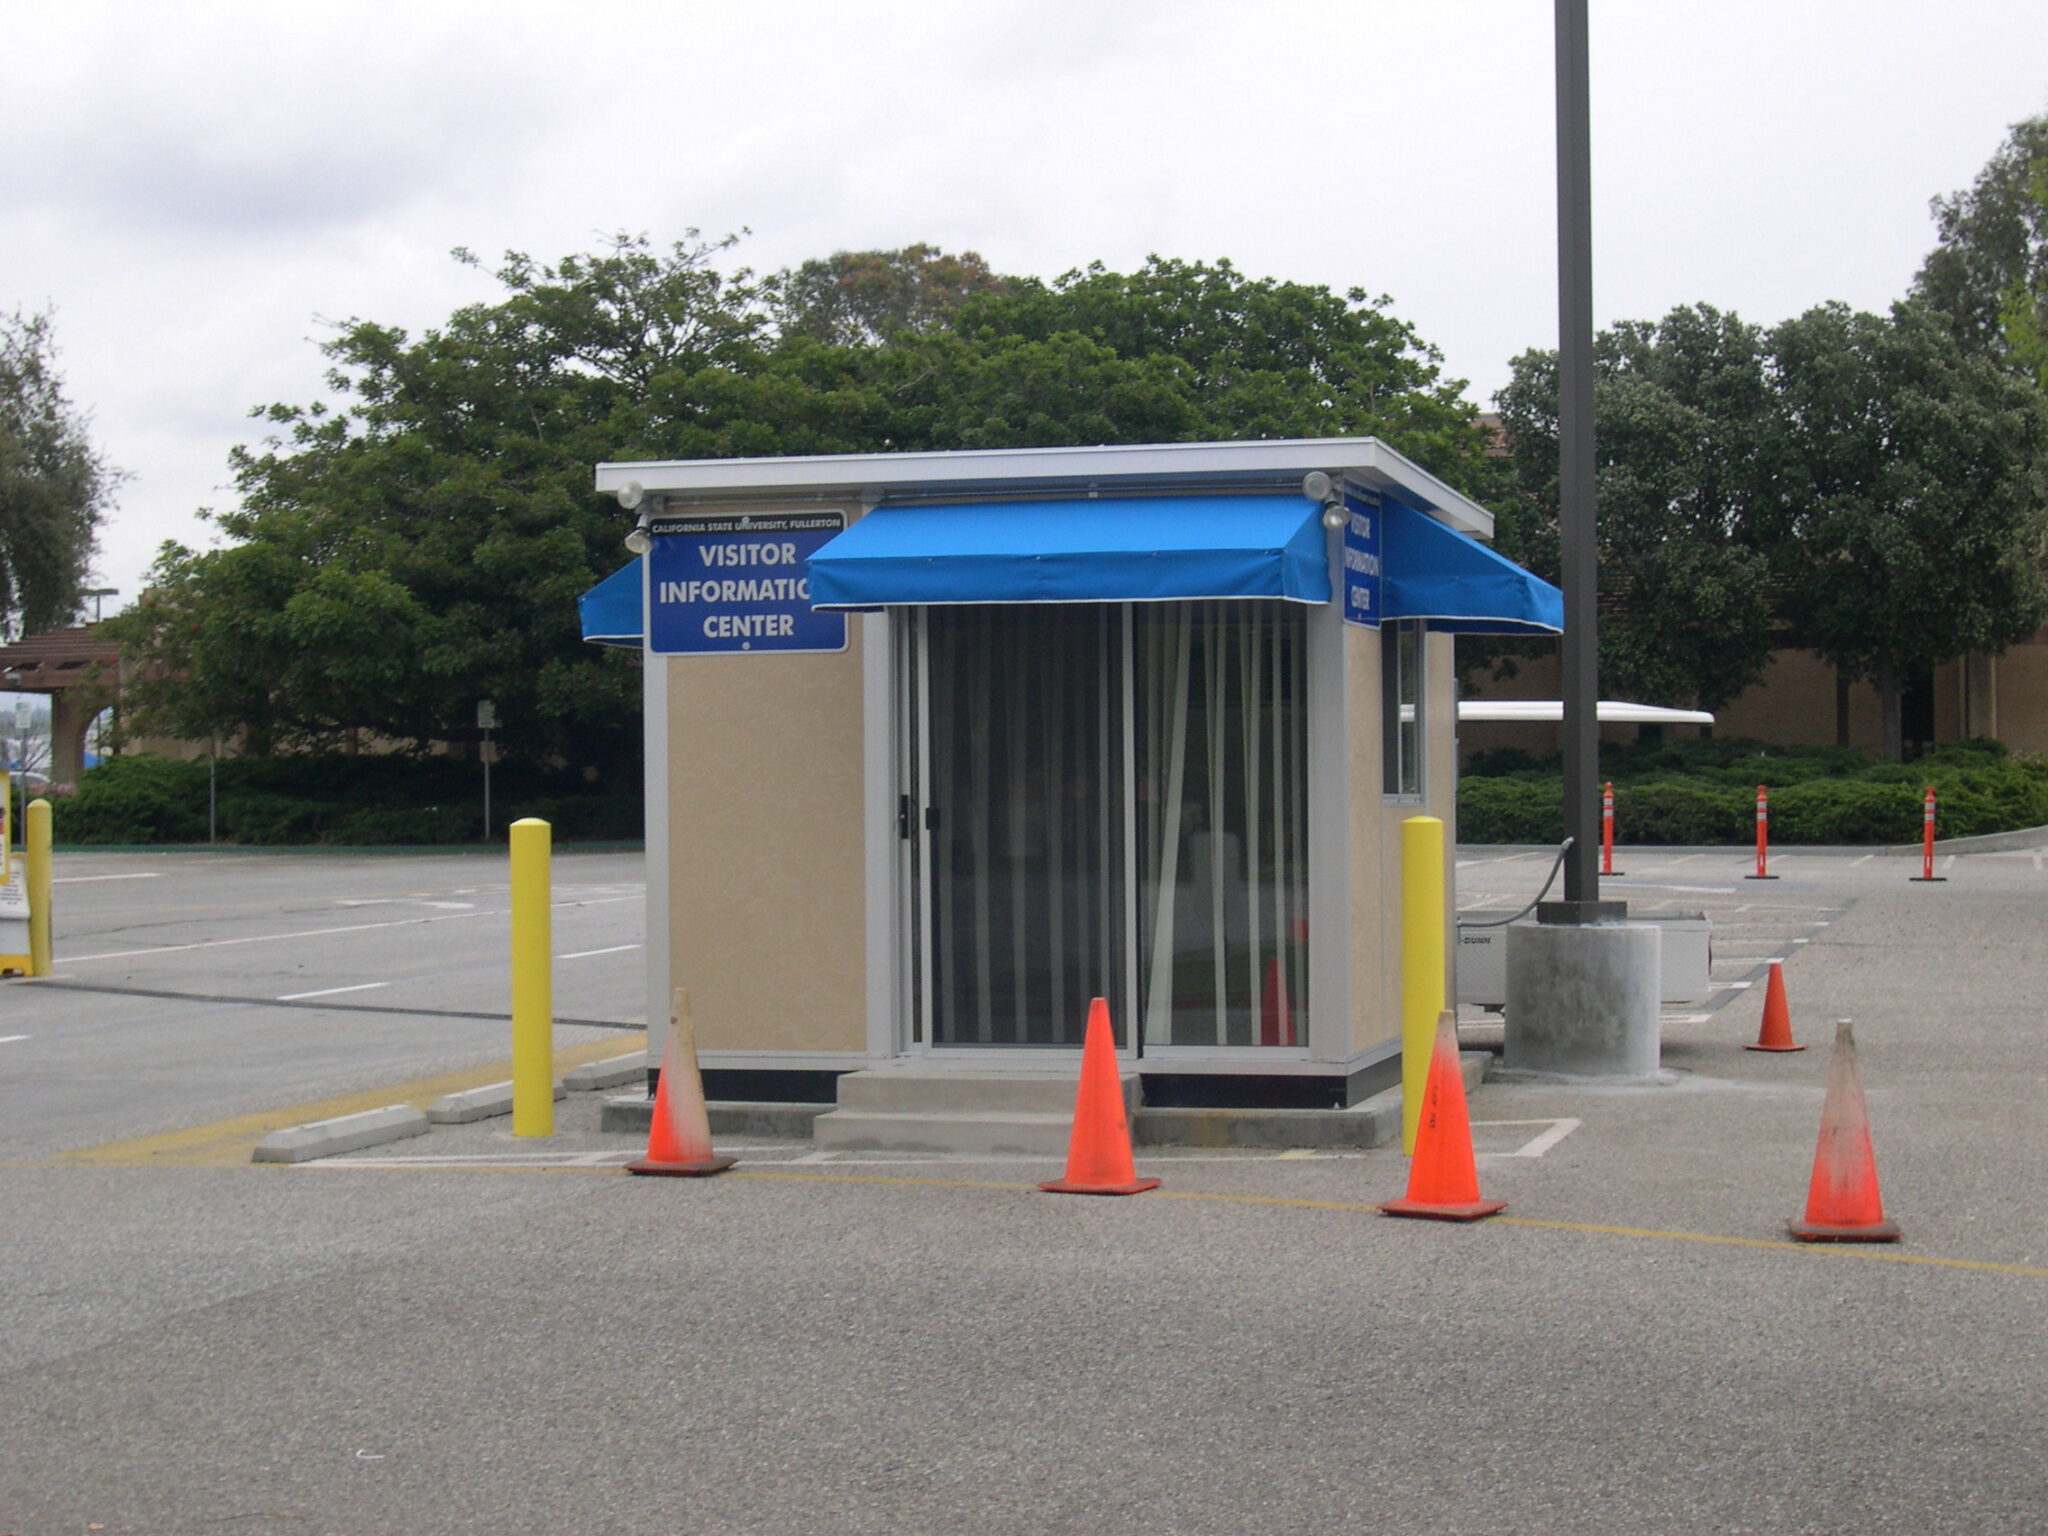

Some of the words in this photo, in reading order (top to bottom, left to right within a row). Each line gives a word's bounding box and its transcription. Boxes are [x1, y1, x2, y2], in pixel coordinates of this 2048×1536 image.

[652, 523, 706, 533] CALIFORNIA
[707, 522, 733, 532] STATE
[790, 518, 841, 529] FULLERTON
[699, 543, 796, 567] VISITOR
[660, 578, 811, 604] INFORMATIO
[703, 614, 794, 638] CENTER
